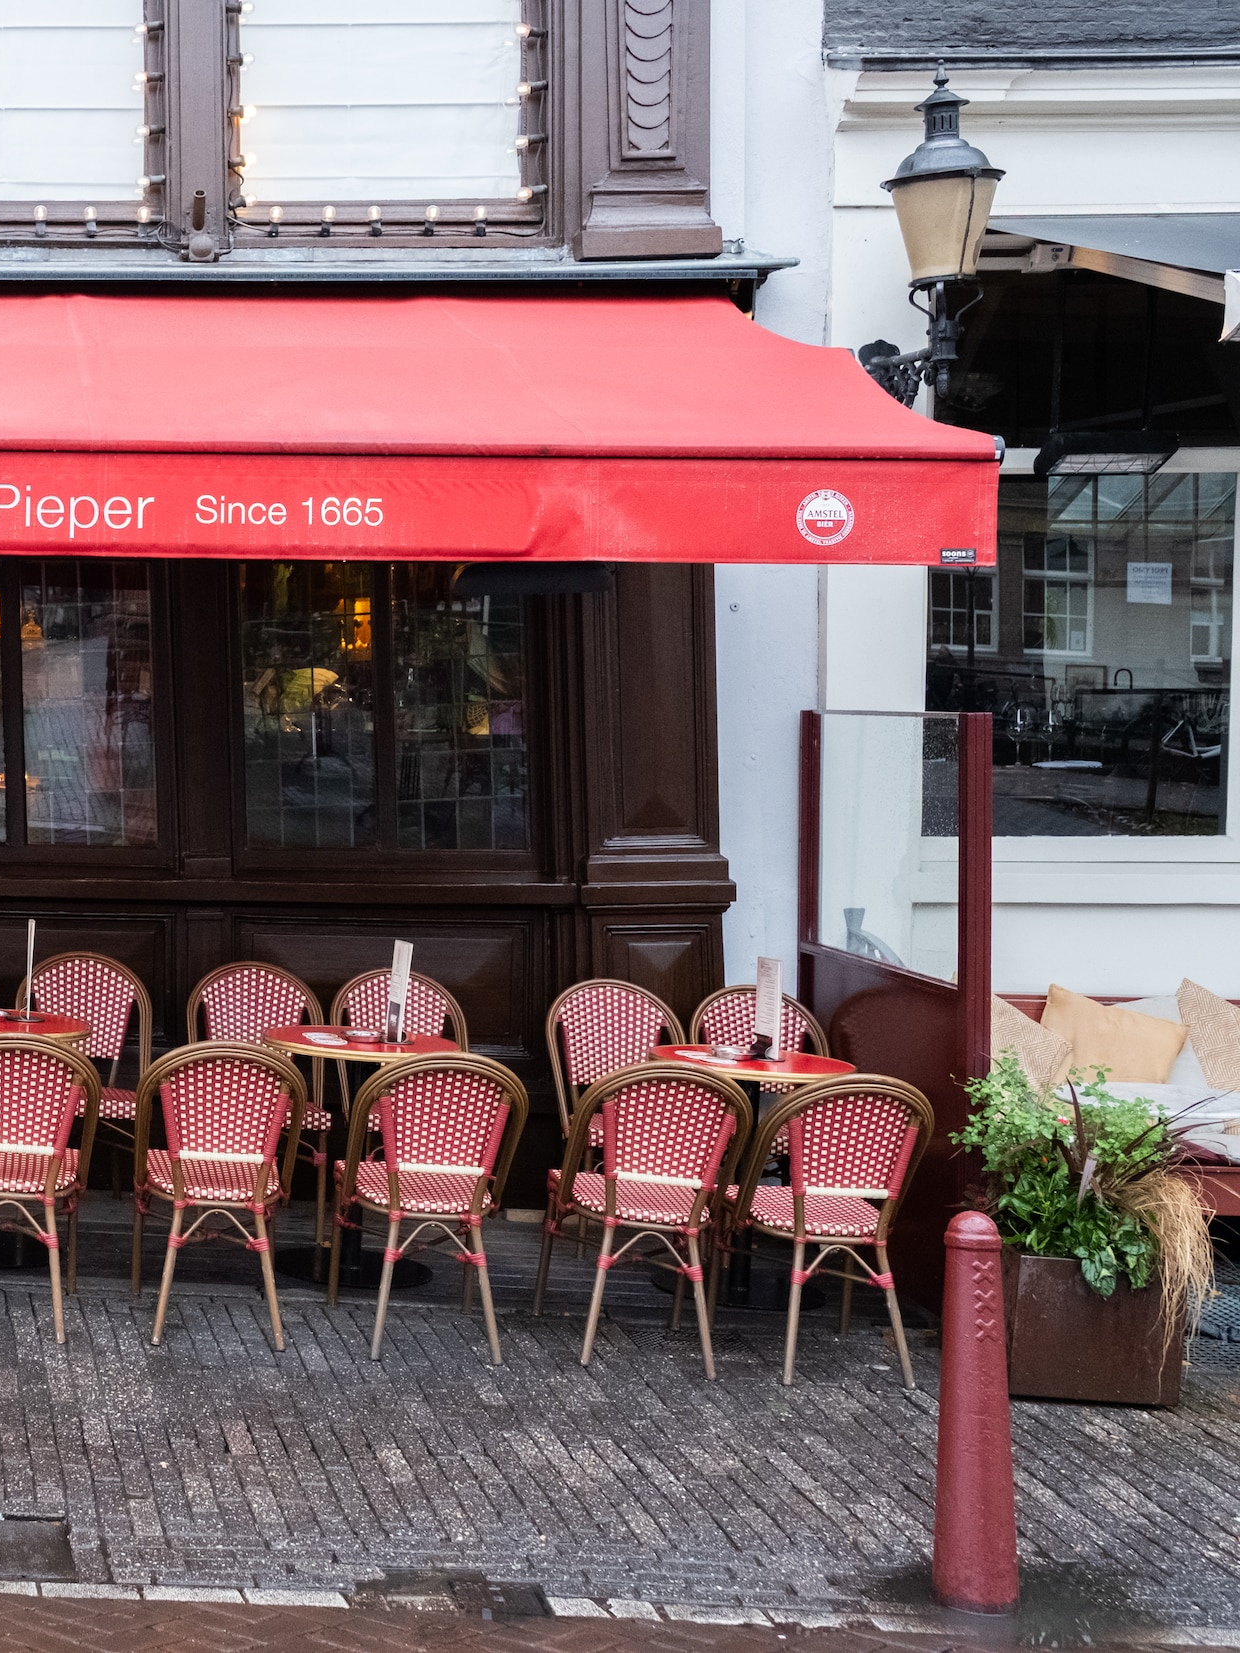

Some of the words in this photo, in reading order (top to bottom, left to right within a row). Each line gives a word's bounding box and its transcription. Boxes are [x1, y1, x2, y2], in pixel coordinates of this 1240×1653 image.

[195, 494, 287, 526] Since
[301, 497, 385, 527] 1665
[807, 509, 844, 518] AMSTEL
